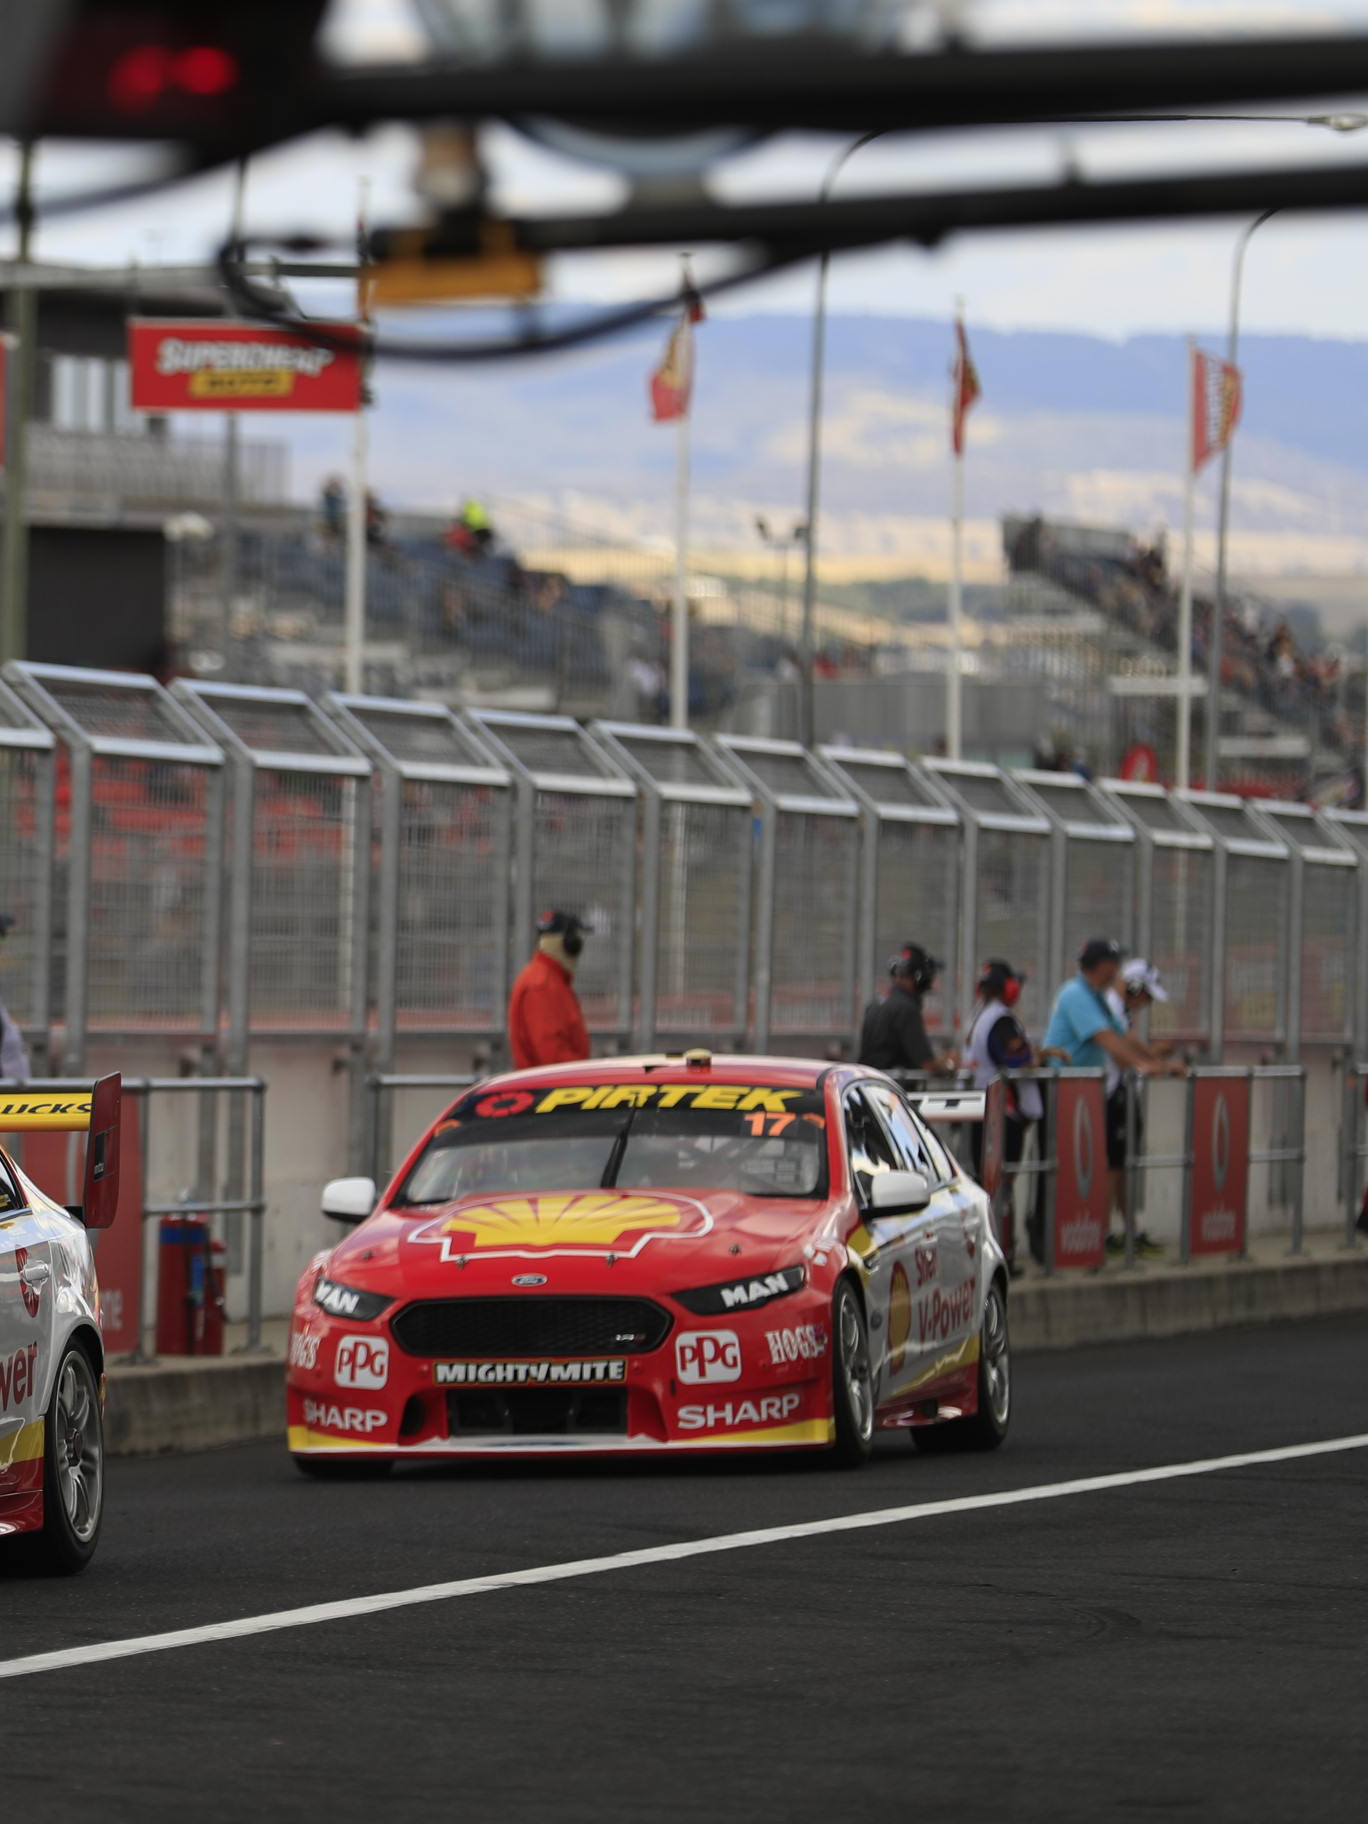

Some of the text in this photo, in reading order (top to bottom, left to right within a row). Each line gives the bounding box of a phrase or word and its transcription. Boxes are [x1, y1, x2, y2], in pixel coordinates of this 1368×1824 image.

[535, 1084, 805, 1114] PIRTEK
[744, 1111, 796, 1137] 17
[720, 1272, 789, 1308] MAN
[337, 1341, 385, 1384] PPG
[436, 1360, 625, 1383] MIGHTYMITE
[679, 1336, 738, 1378] PPG
[303, 1397, 388, 1433] SHARP
[678, 1392, 800, 1430] SHARP
